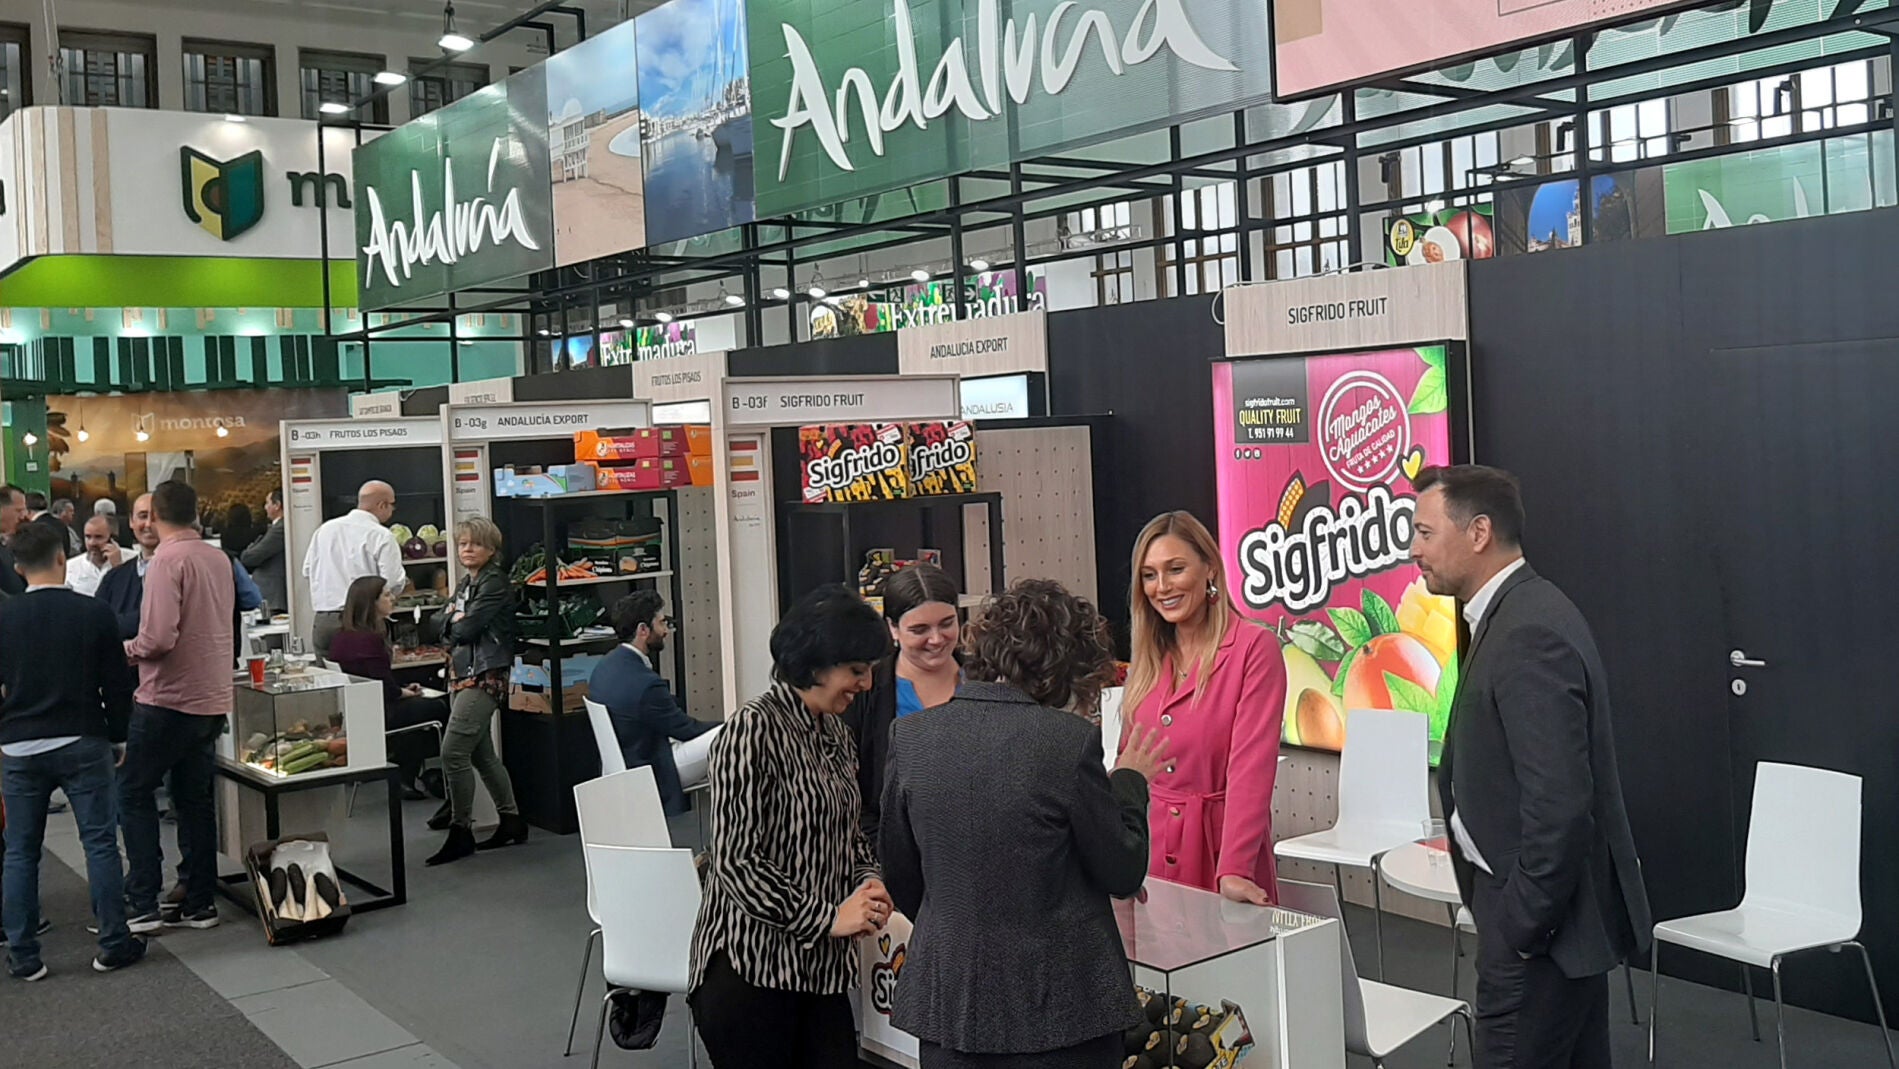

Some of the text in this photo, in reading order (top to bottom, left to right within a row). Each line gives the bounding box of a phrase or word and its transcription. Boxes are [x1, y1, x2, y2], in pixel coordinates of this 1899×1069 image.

[361, 136, 540, 289] Andalucía
[1288, 297, 1388, 325] SIGFRIDO FRUIT
[930, 337, 1008, 360] ANDALUCÍA EXPORT
[651, 374, 671, 387] FRUTOS
[672, 373, 682, 385] LOS
[780, 394, 831, 408] SIGFRIDO
[834, 394, 864, 407] FRUIT
[960, 402, 1013, 415] ANDALUSIA
[1245, 396, 1296, 409] sigfridofruit.com
[160, 414, 246, 431] montosa
[497, 413, 551, 426] ANDALUCÍA
[553, 413, 589, 425] EXPORT
[1239, 408, 1301, 427] QUALITY FRUIT
[1329, 395, 1381, 440] Mangos
[330, 429, 361, 439] FRUTOS
[363, 429, 378, 438] LOS
[1254, 427, 1266, 439] 951
[1267, 427, 1275, 439] 91
[1276, 427, 1284, 438] 99
[1285, 426, 1294, 438] 44
[1329, 405, 1397, 461] Aguacates
[1346, 429, 1395, 469] FRUTA DE CALIDAD
[809, 441, 898, 488] Sigfrido
[731, 489, 756, 499] Spain
[1242, 494, 1415, 606] Sigfrido
